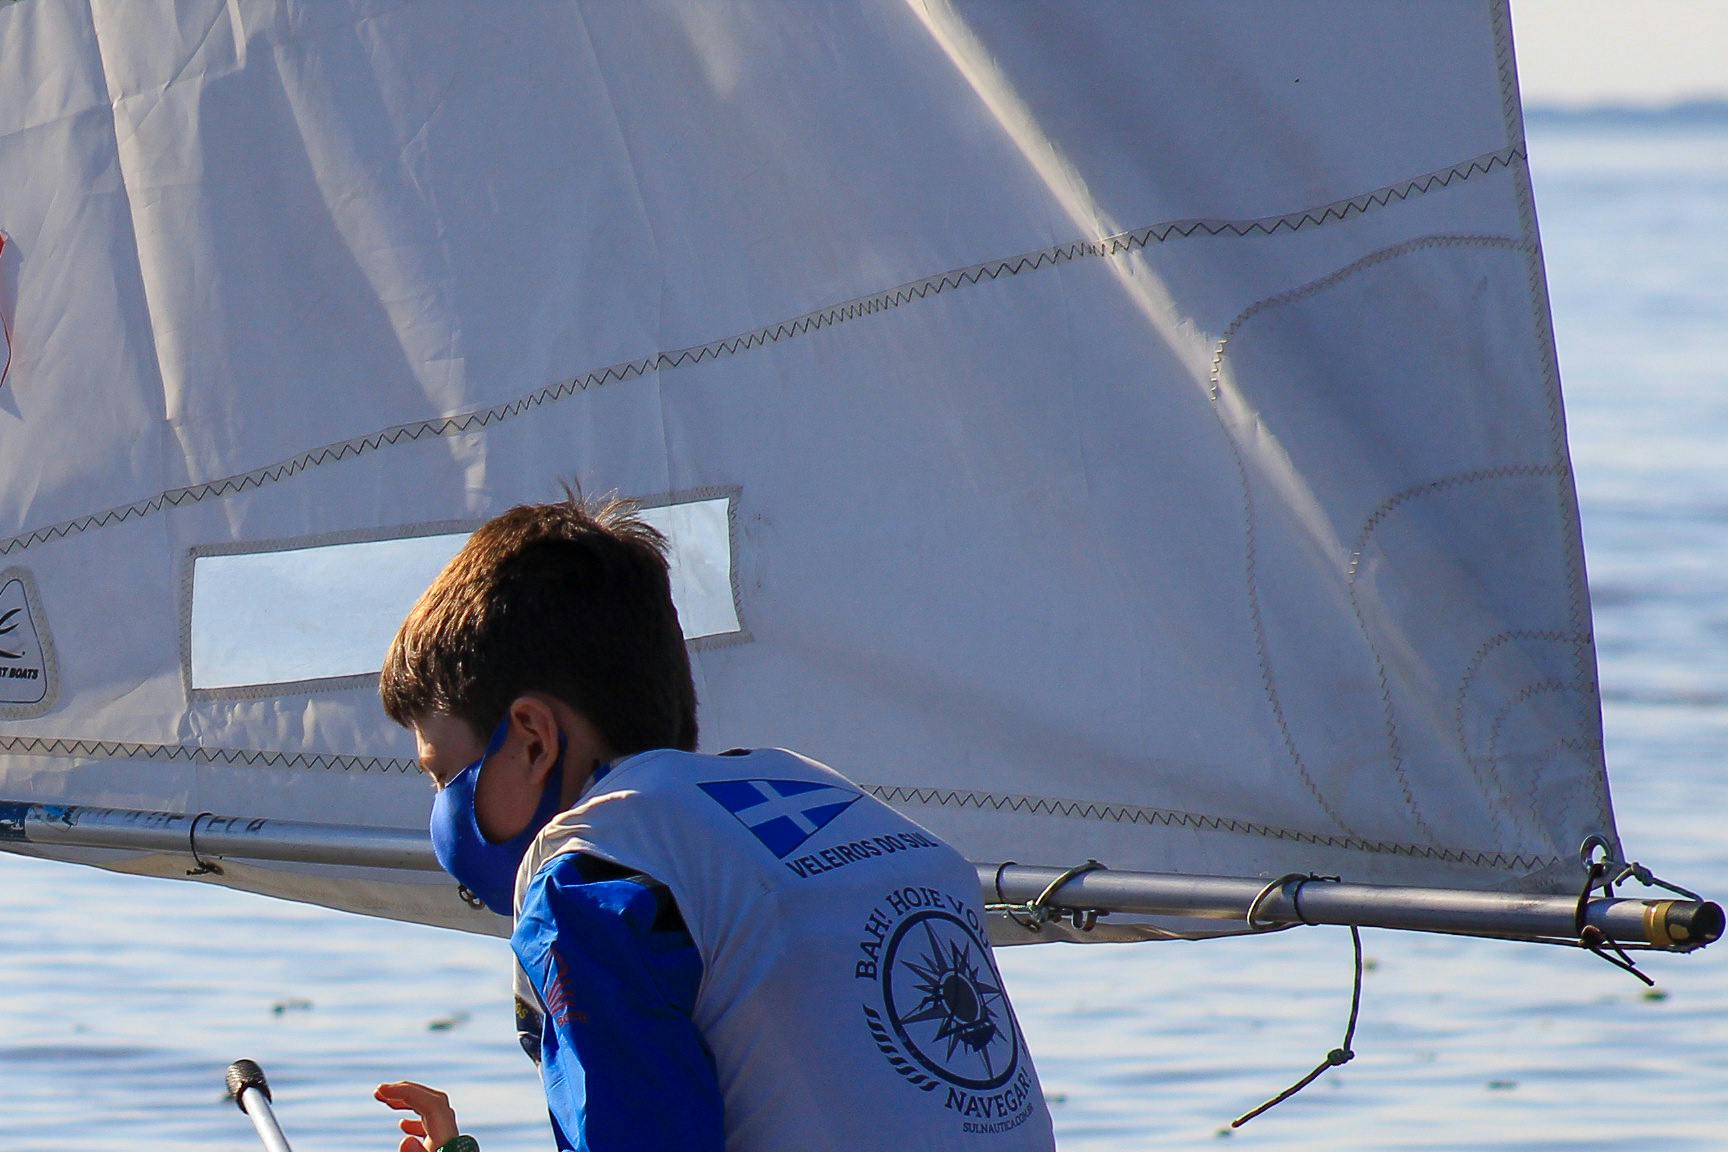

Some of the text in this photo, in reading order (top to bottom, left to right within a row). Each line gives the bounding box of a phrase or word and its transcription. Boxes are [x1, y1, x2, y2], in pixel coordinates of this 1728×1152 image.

[8, 668, 39, 680] BOATS
[785, 831, 938, 879] VELEIROS DO SUL
[855, 908, 893, 981] BAH!
[886, 887, 945, 916] HOJE
[945, 1068, 1033, 1119] NAVEGAR!
